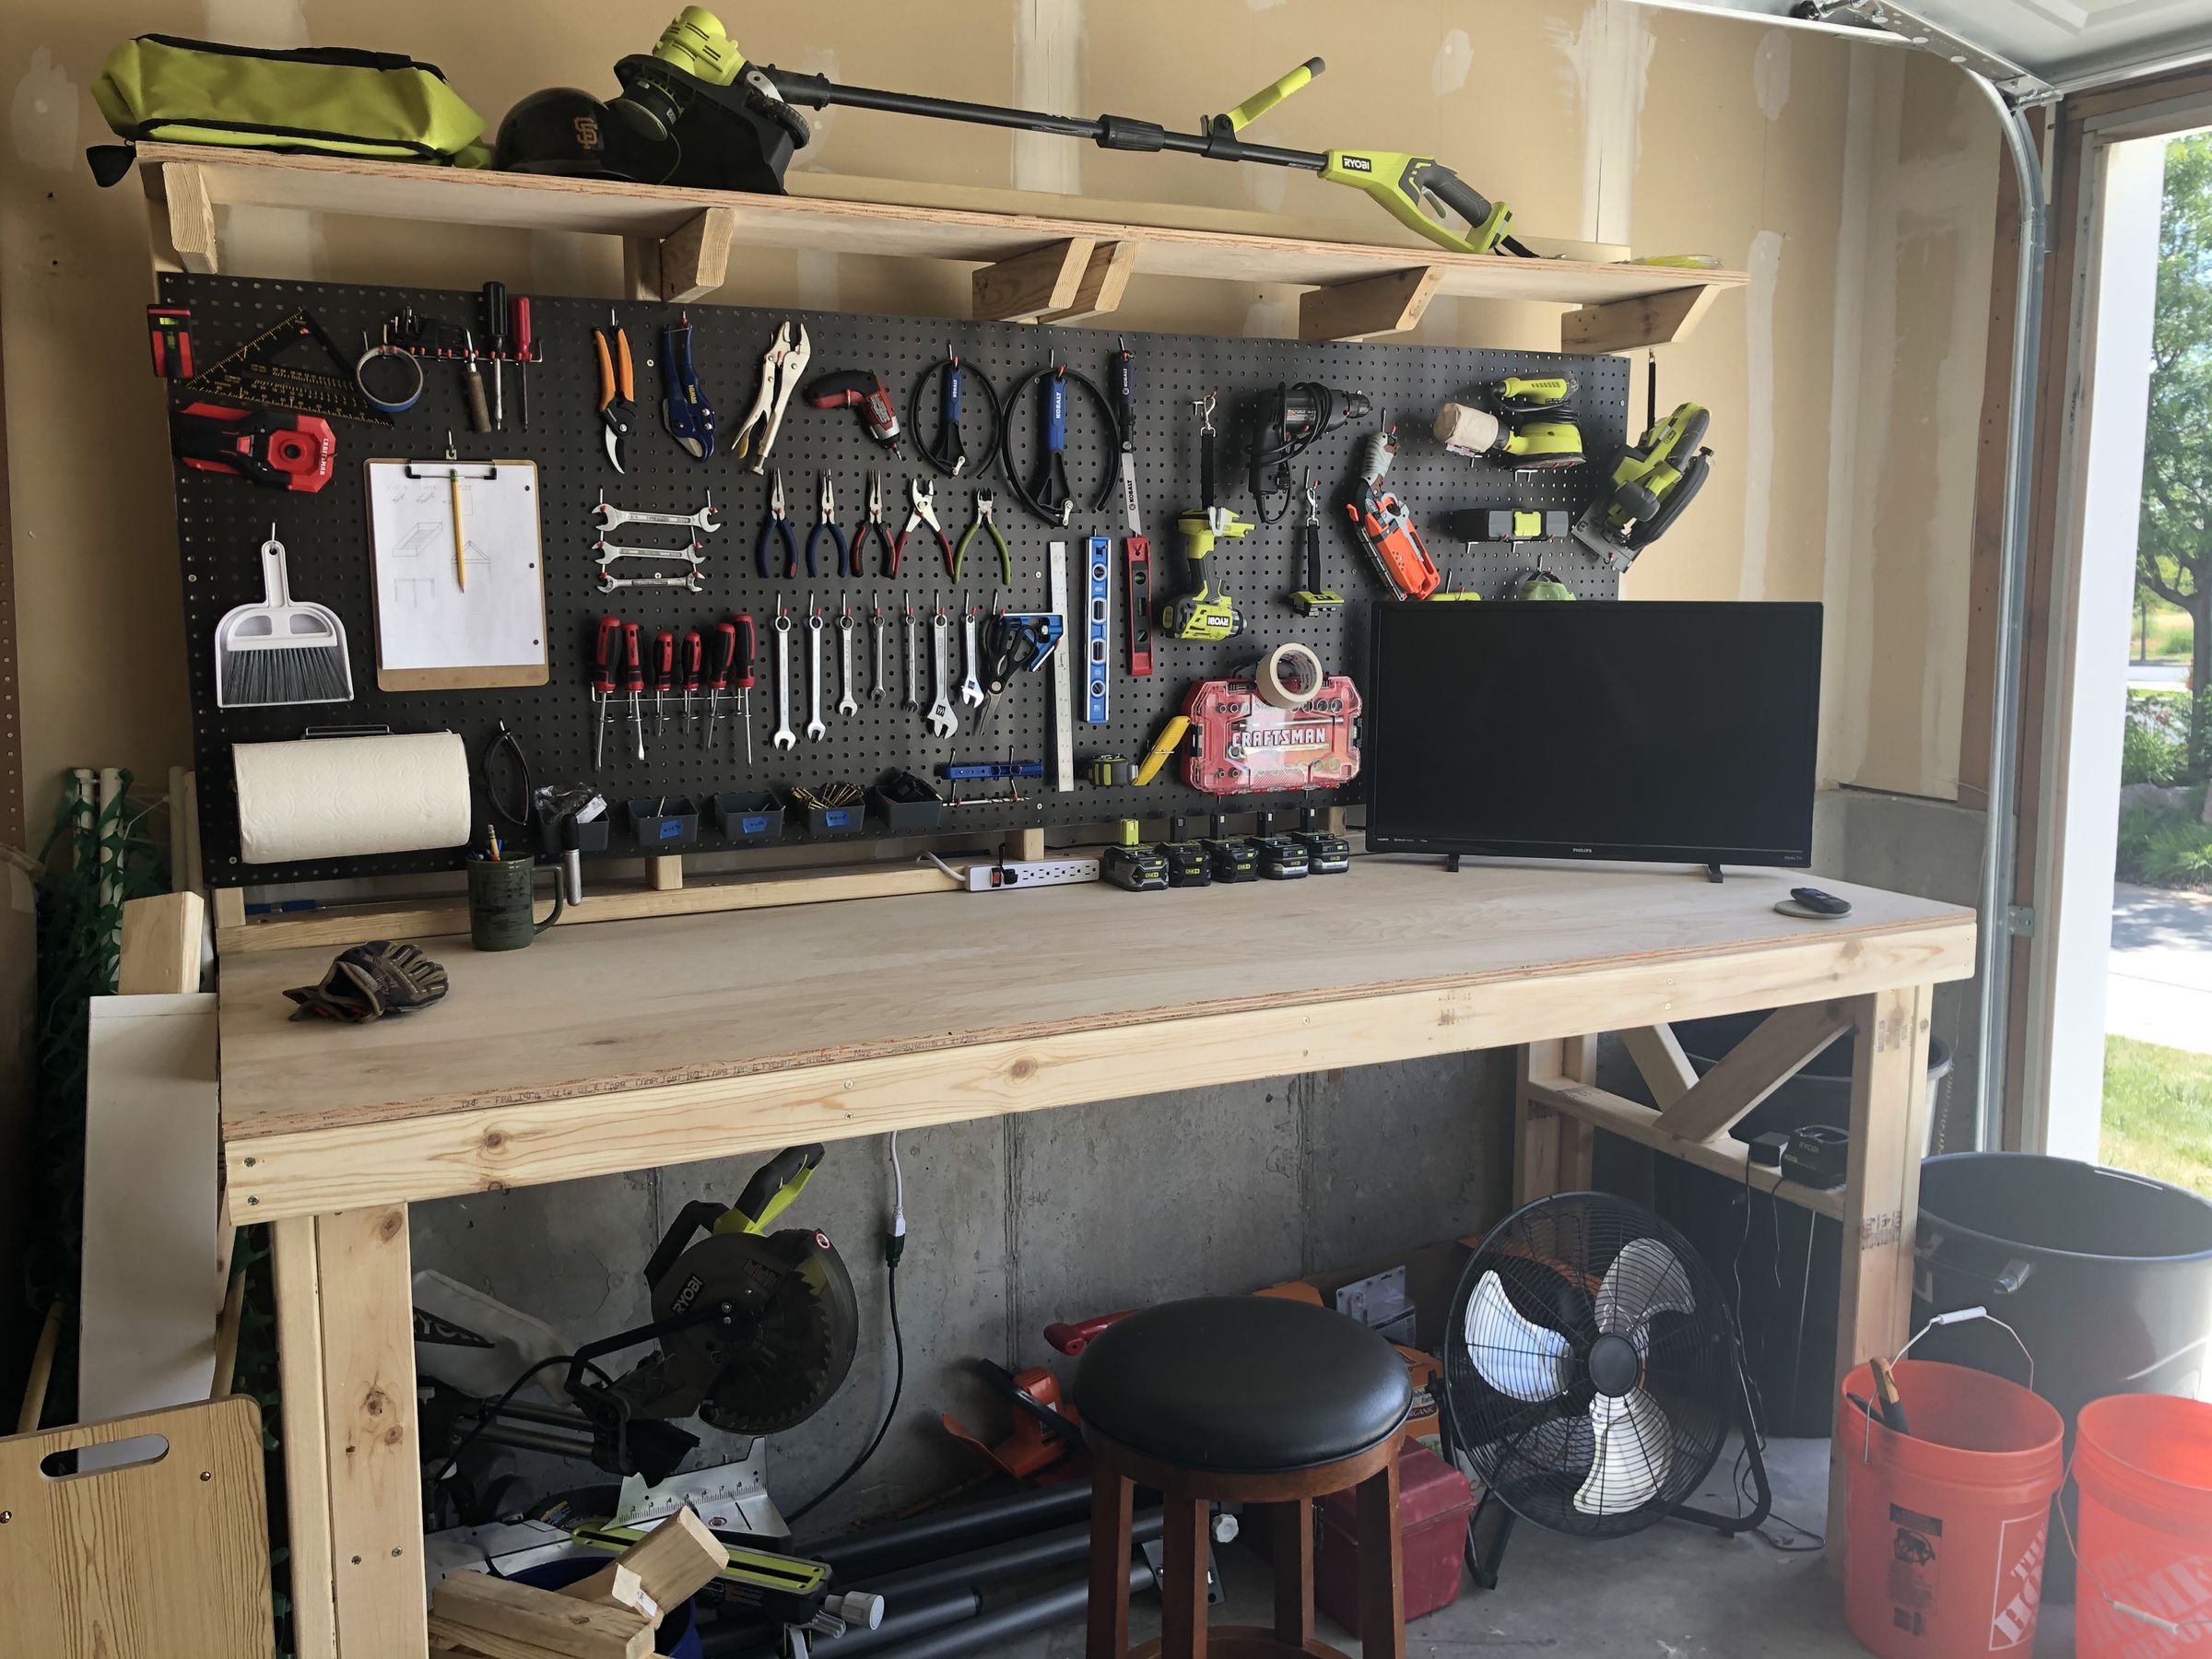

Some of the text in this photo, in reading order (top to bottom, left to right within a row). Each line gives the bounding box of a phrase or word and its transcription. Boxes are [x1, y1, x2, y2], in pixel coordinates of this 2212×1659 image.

[1343, 158, 1370, 171] RYOBI
[319, 438, 329, 476] CRAFTSMAN
[1207, 617, 1230, 627] RYOBI
[1231, 727, 1325, 747] CRAFTSMAN
[672, 1276, 703, 1315] RYOBI
